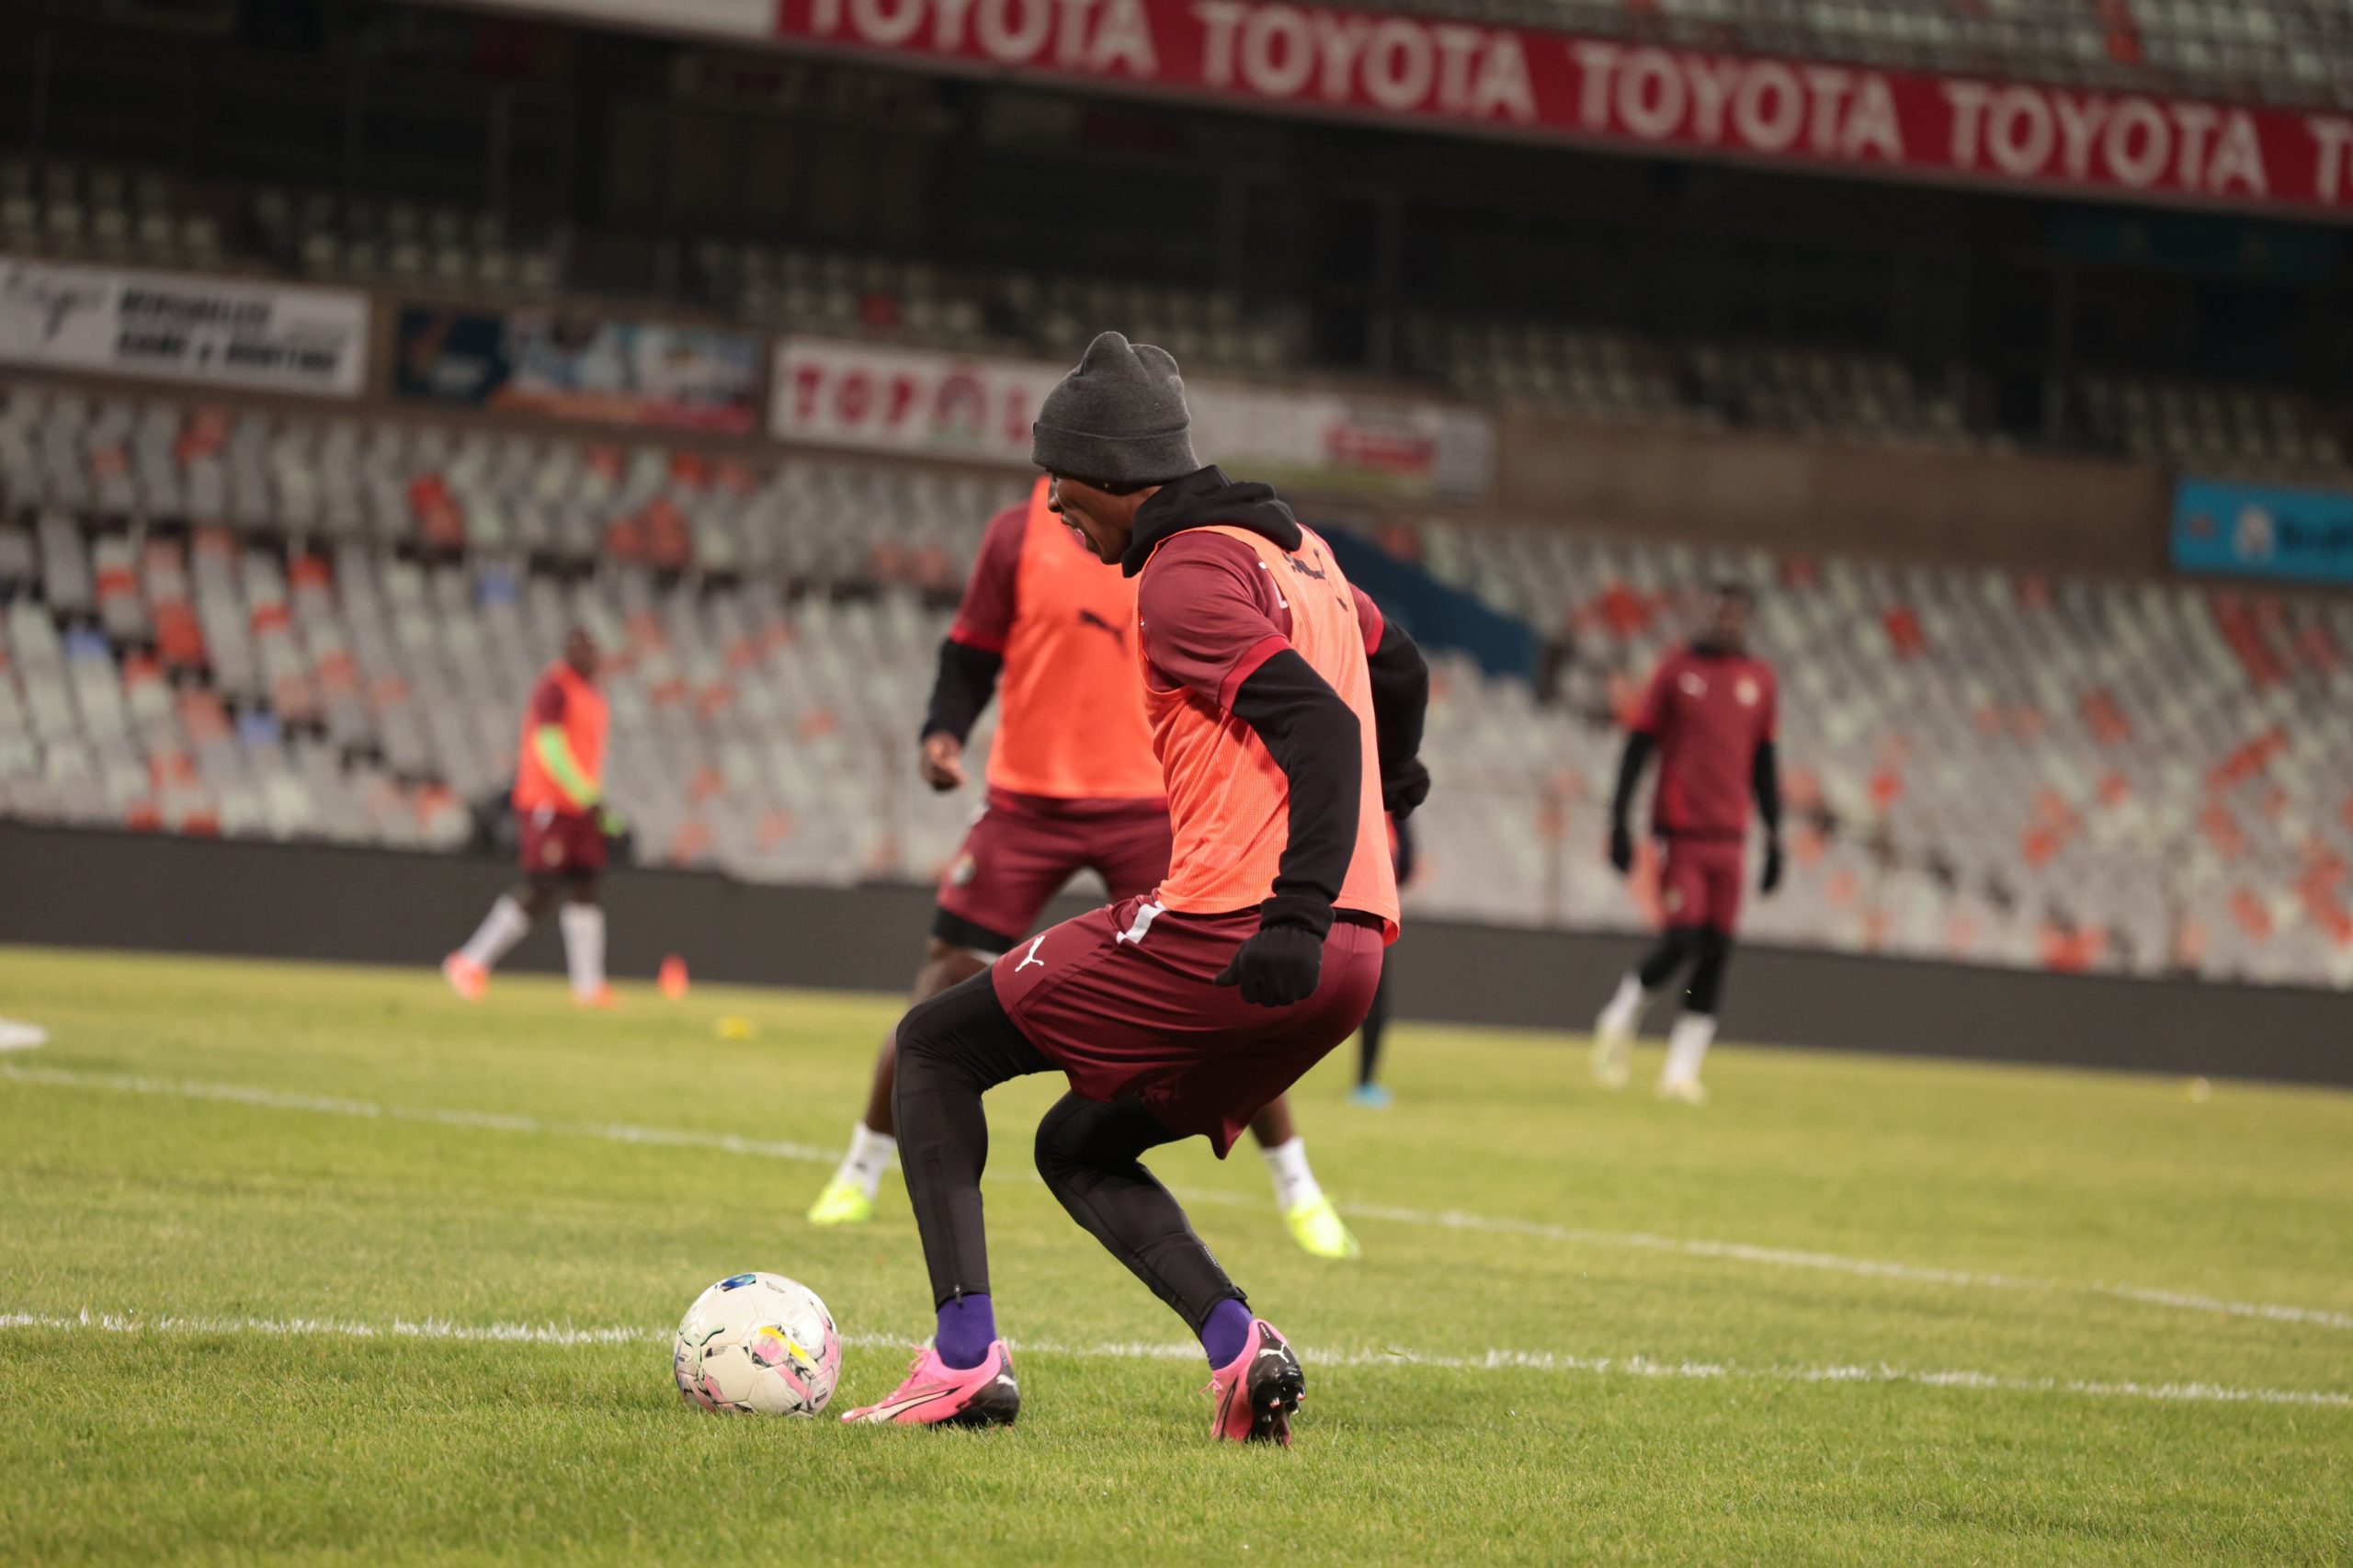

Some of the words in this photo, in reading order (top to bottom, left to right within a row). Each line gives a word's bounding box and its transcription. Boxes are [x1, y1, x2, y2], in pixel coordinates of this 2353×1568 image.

[1194, 3, 1539, 120] TOYOTA
[1568, 40, 1906, 164] TOYOTA
[1940, 79, 2268, 197] TOYOTA
